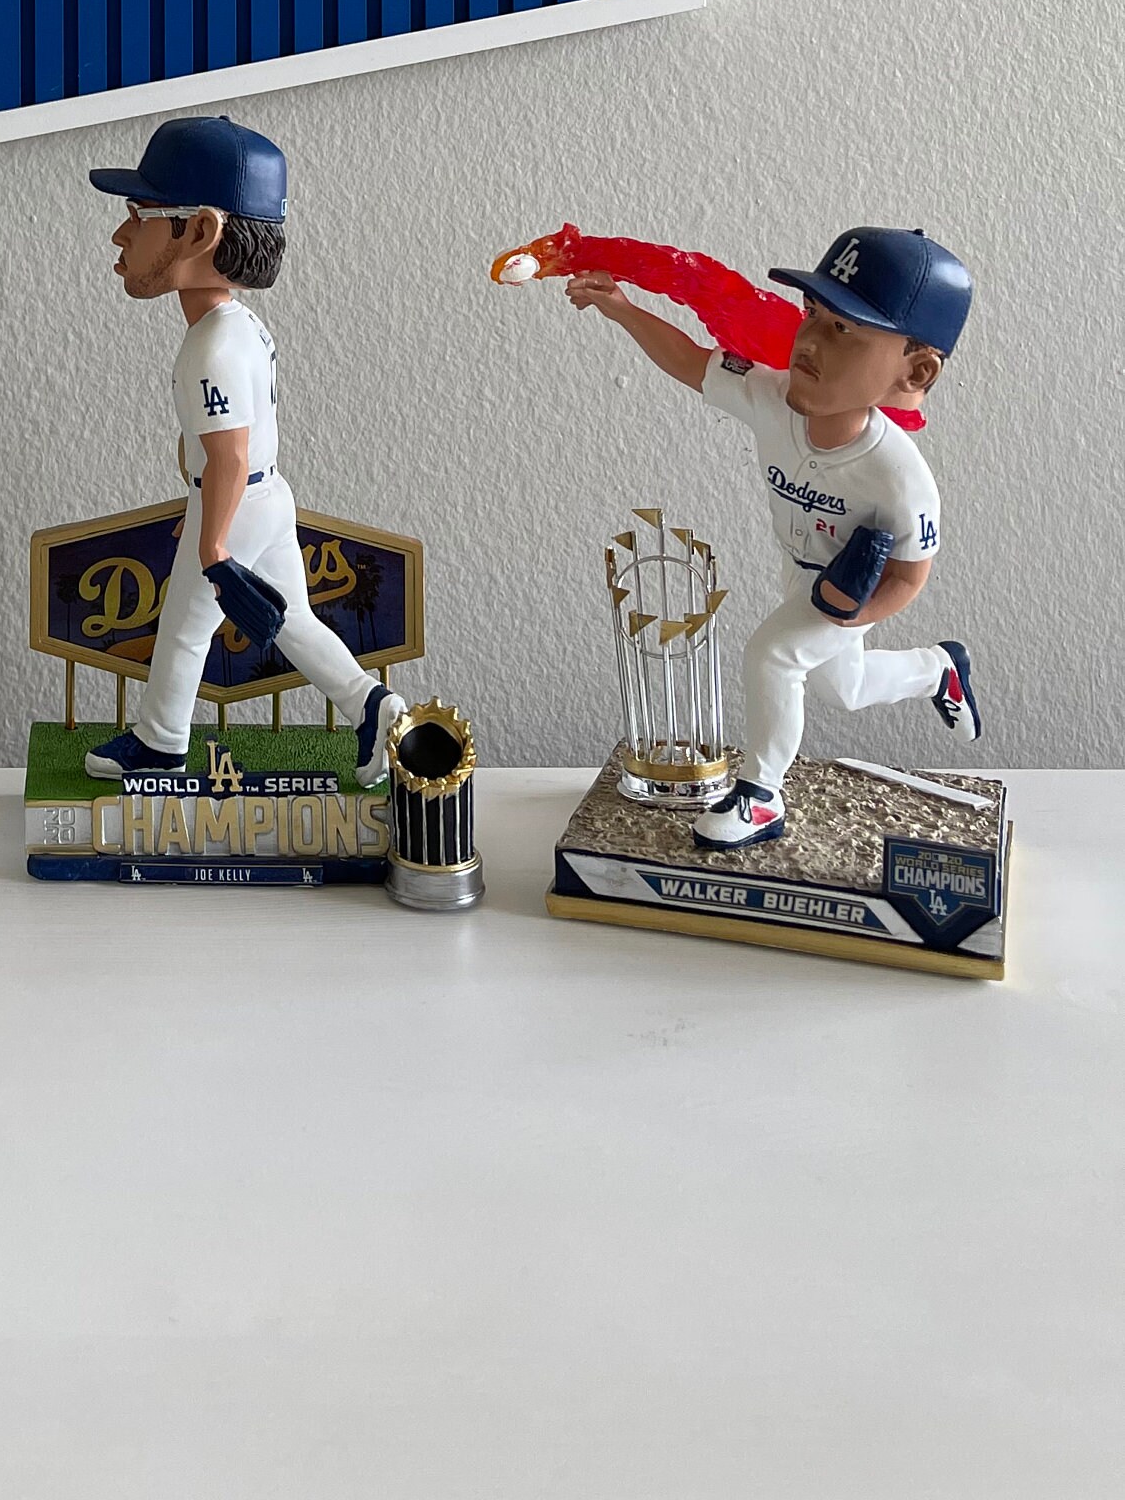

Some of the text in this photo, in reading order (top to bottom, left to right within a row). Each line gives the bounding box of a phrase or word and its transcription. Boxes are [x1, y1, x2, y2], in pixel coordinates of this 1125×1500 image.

[833, 237, 859, 284] LA
[200, 379, 229, 417] LA
[767, 465, 846, 516] Dodgers
[816, 518, 835, 538] 21
[919, 513, 937, 550] LA
[124, 778, 200, 793] WORLD
[207, 740, 243, 793] LA
[265, 777, 338, 793] SERIES
[91, 796, 390, 857] CHAMPIONS
[194, 869, 213, 881] JOE
[219, 869, 251, 881] KELLY
[895, 856, 985, 877] WORLD SERIES
[895, 865, 986, 896] CHAMPIONS
[660, 878, 866, 924] WALKER BUEHLER
[929, 889, 947, 916] LA
